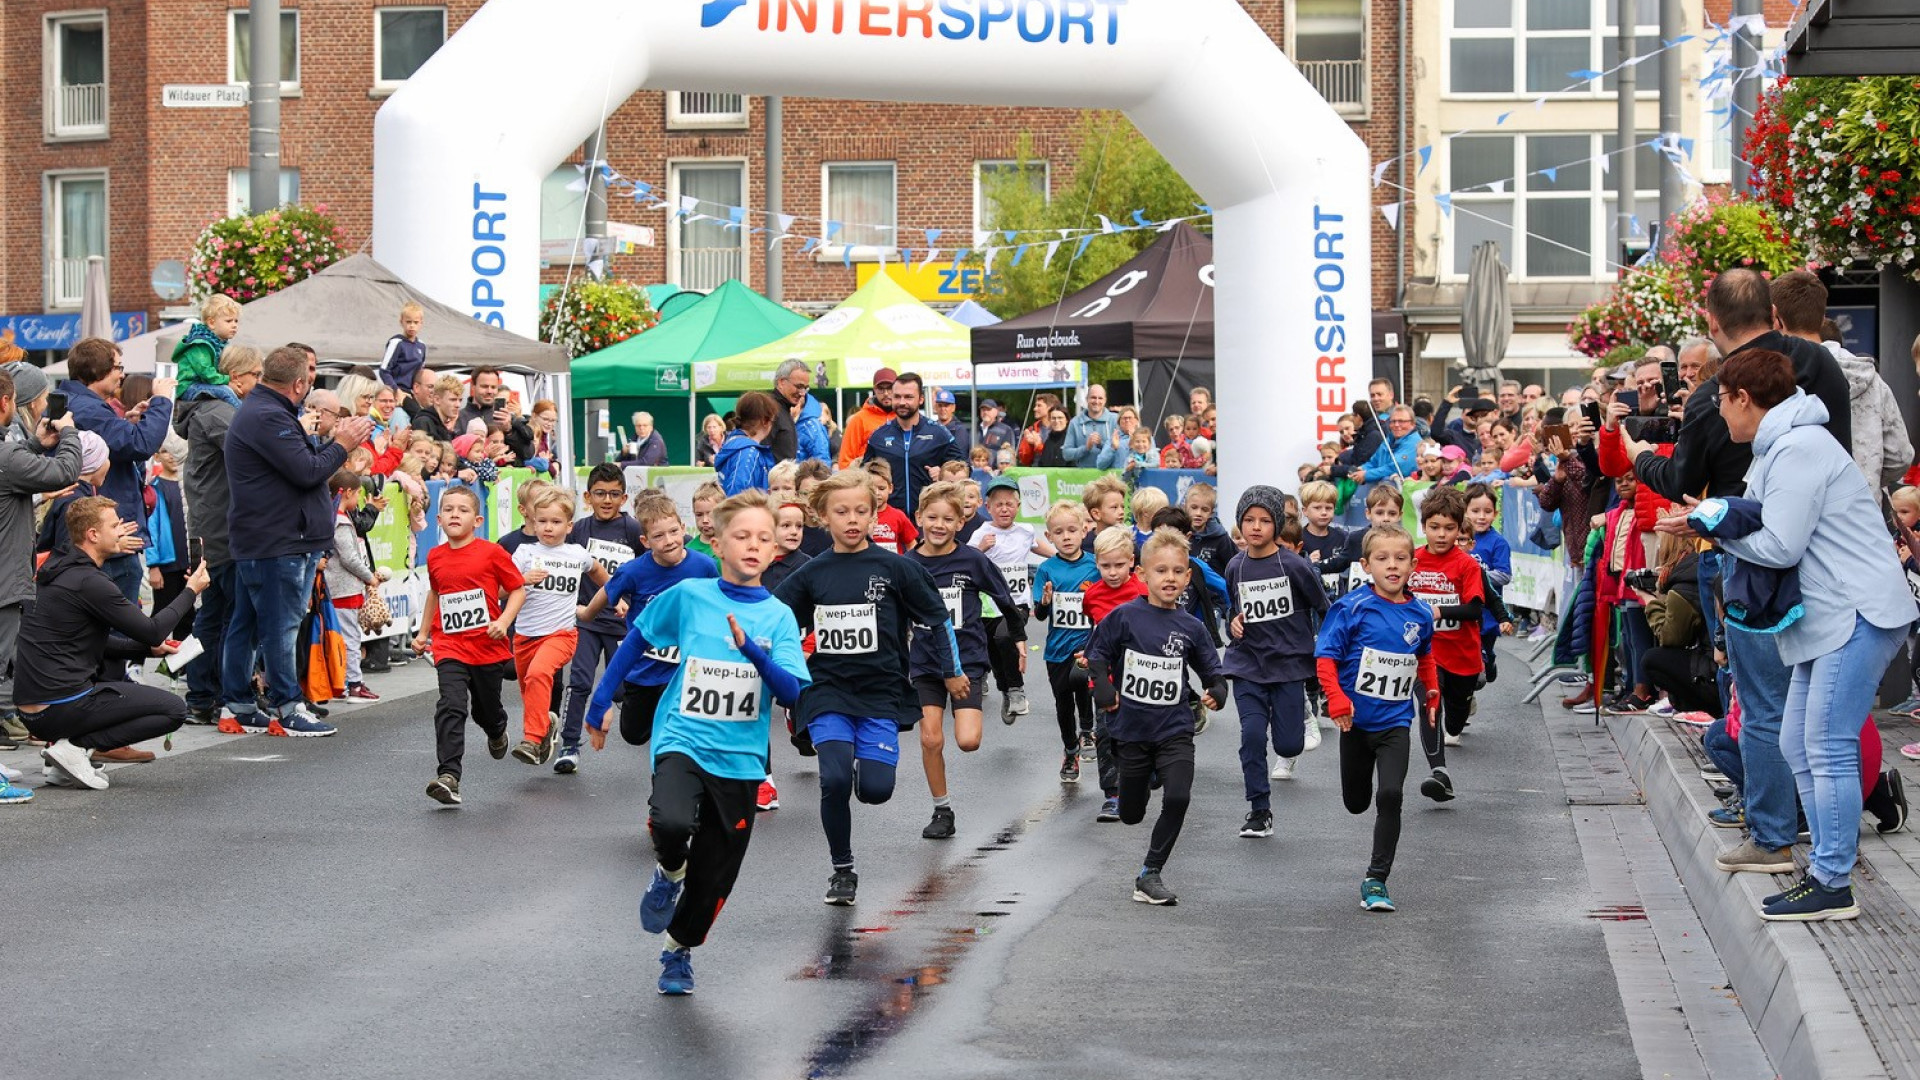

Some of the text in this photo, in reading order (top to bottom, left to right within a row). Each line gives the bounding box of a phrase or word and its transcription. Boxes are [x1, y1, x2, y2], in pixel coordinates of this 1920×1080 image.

[757, 0, 1127, 46] INTERSPORT
[168, 89, 241, 102] Wildauer Platz
[1313, 204, 1347, 450] TERSPORT
[1016, 330, 1081, 349] Run on clouds.
[1022, 488, 1041, 502] wep
[1009, 578, 1026, 593] 26
[1248, 579, 1289, 593] wep-Lauf
[447, 589, 484, 605] wep-Lauf
[942, 590, 961, 600] Lauf
[825, 607, 875, 620] wep-Lauf
[1243, 596, 1290, 620] 2049
[443, 607, 487, 630] 2022
[1056, 609, 1092, 626] 201
[818, 627, 873, 650] 2050
[1137, 658, 1181, 671] wep-Lauf
[1378, 655, 1417, 668] wep-Lau
[1124, 673, 1178, 701] 2069
[1359, 671, 1412, 697] 2114
[685, 686, 755, 717] 2014
